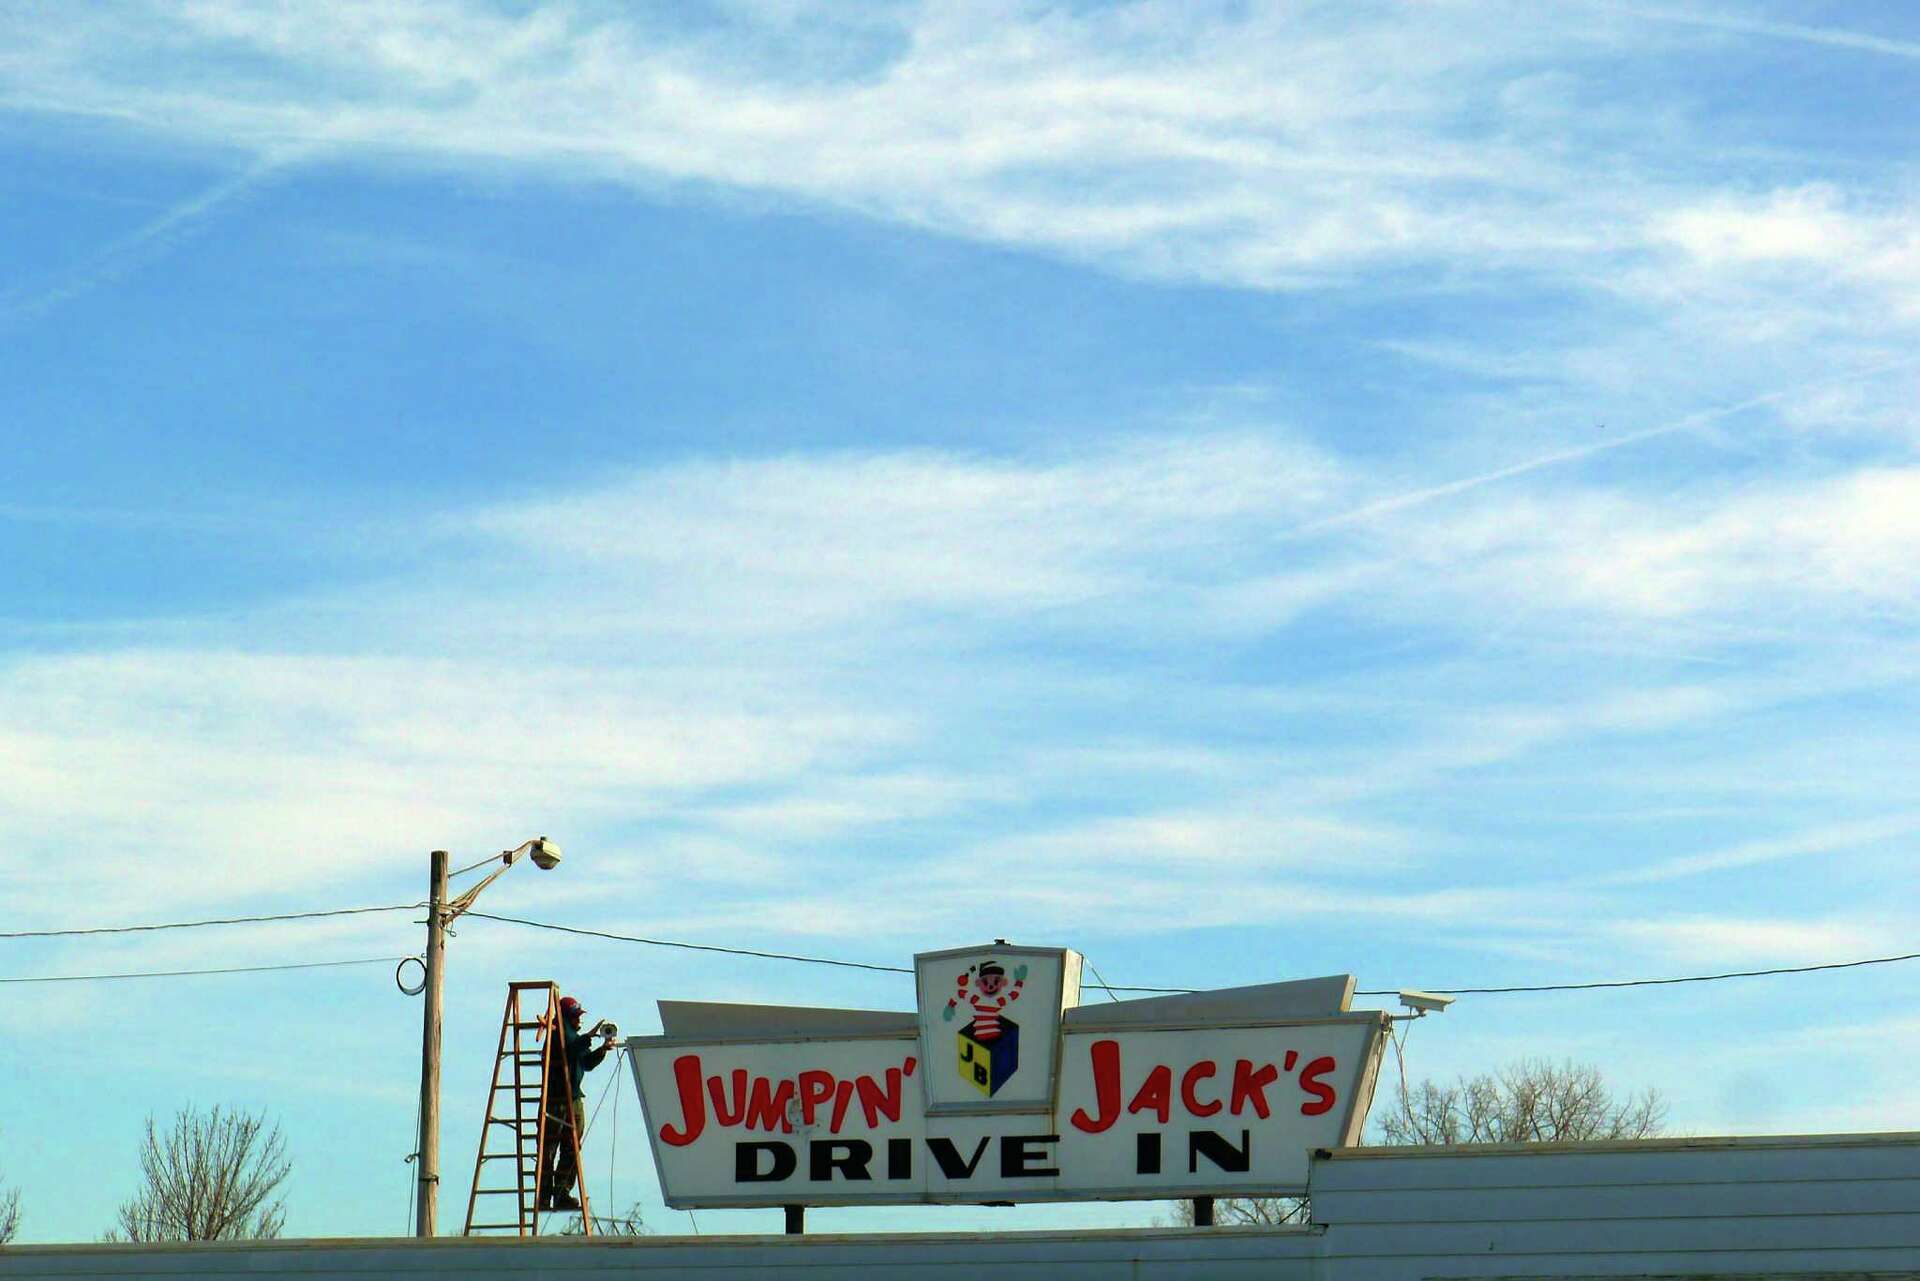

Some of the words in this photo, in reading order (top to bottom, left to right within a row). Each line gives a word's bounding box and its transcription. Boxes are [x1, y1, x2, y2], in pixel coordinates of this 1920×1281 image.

[659, 1054, 917, 1147] JUMPIN'
[1070, 1039, 1336, 1134] JACK'S
[735, 1135, 1061, 1183] DRIVE
[1136, 1129, 1250, 1175] IN
